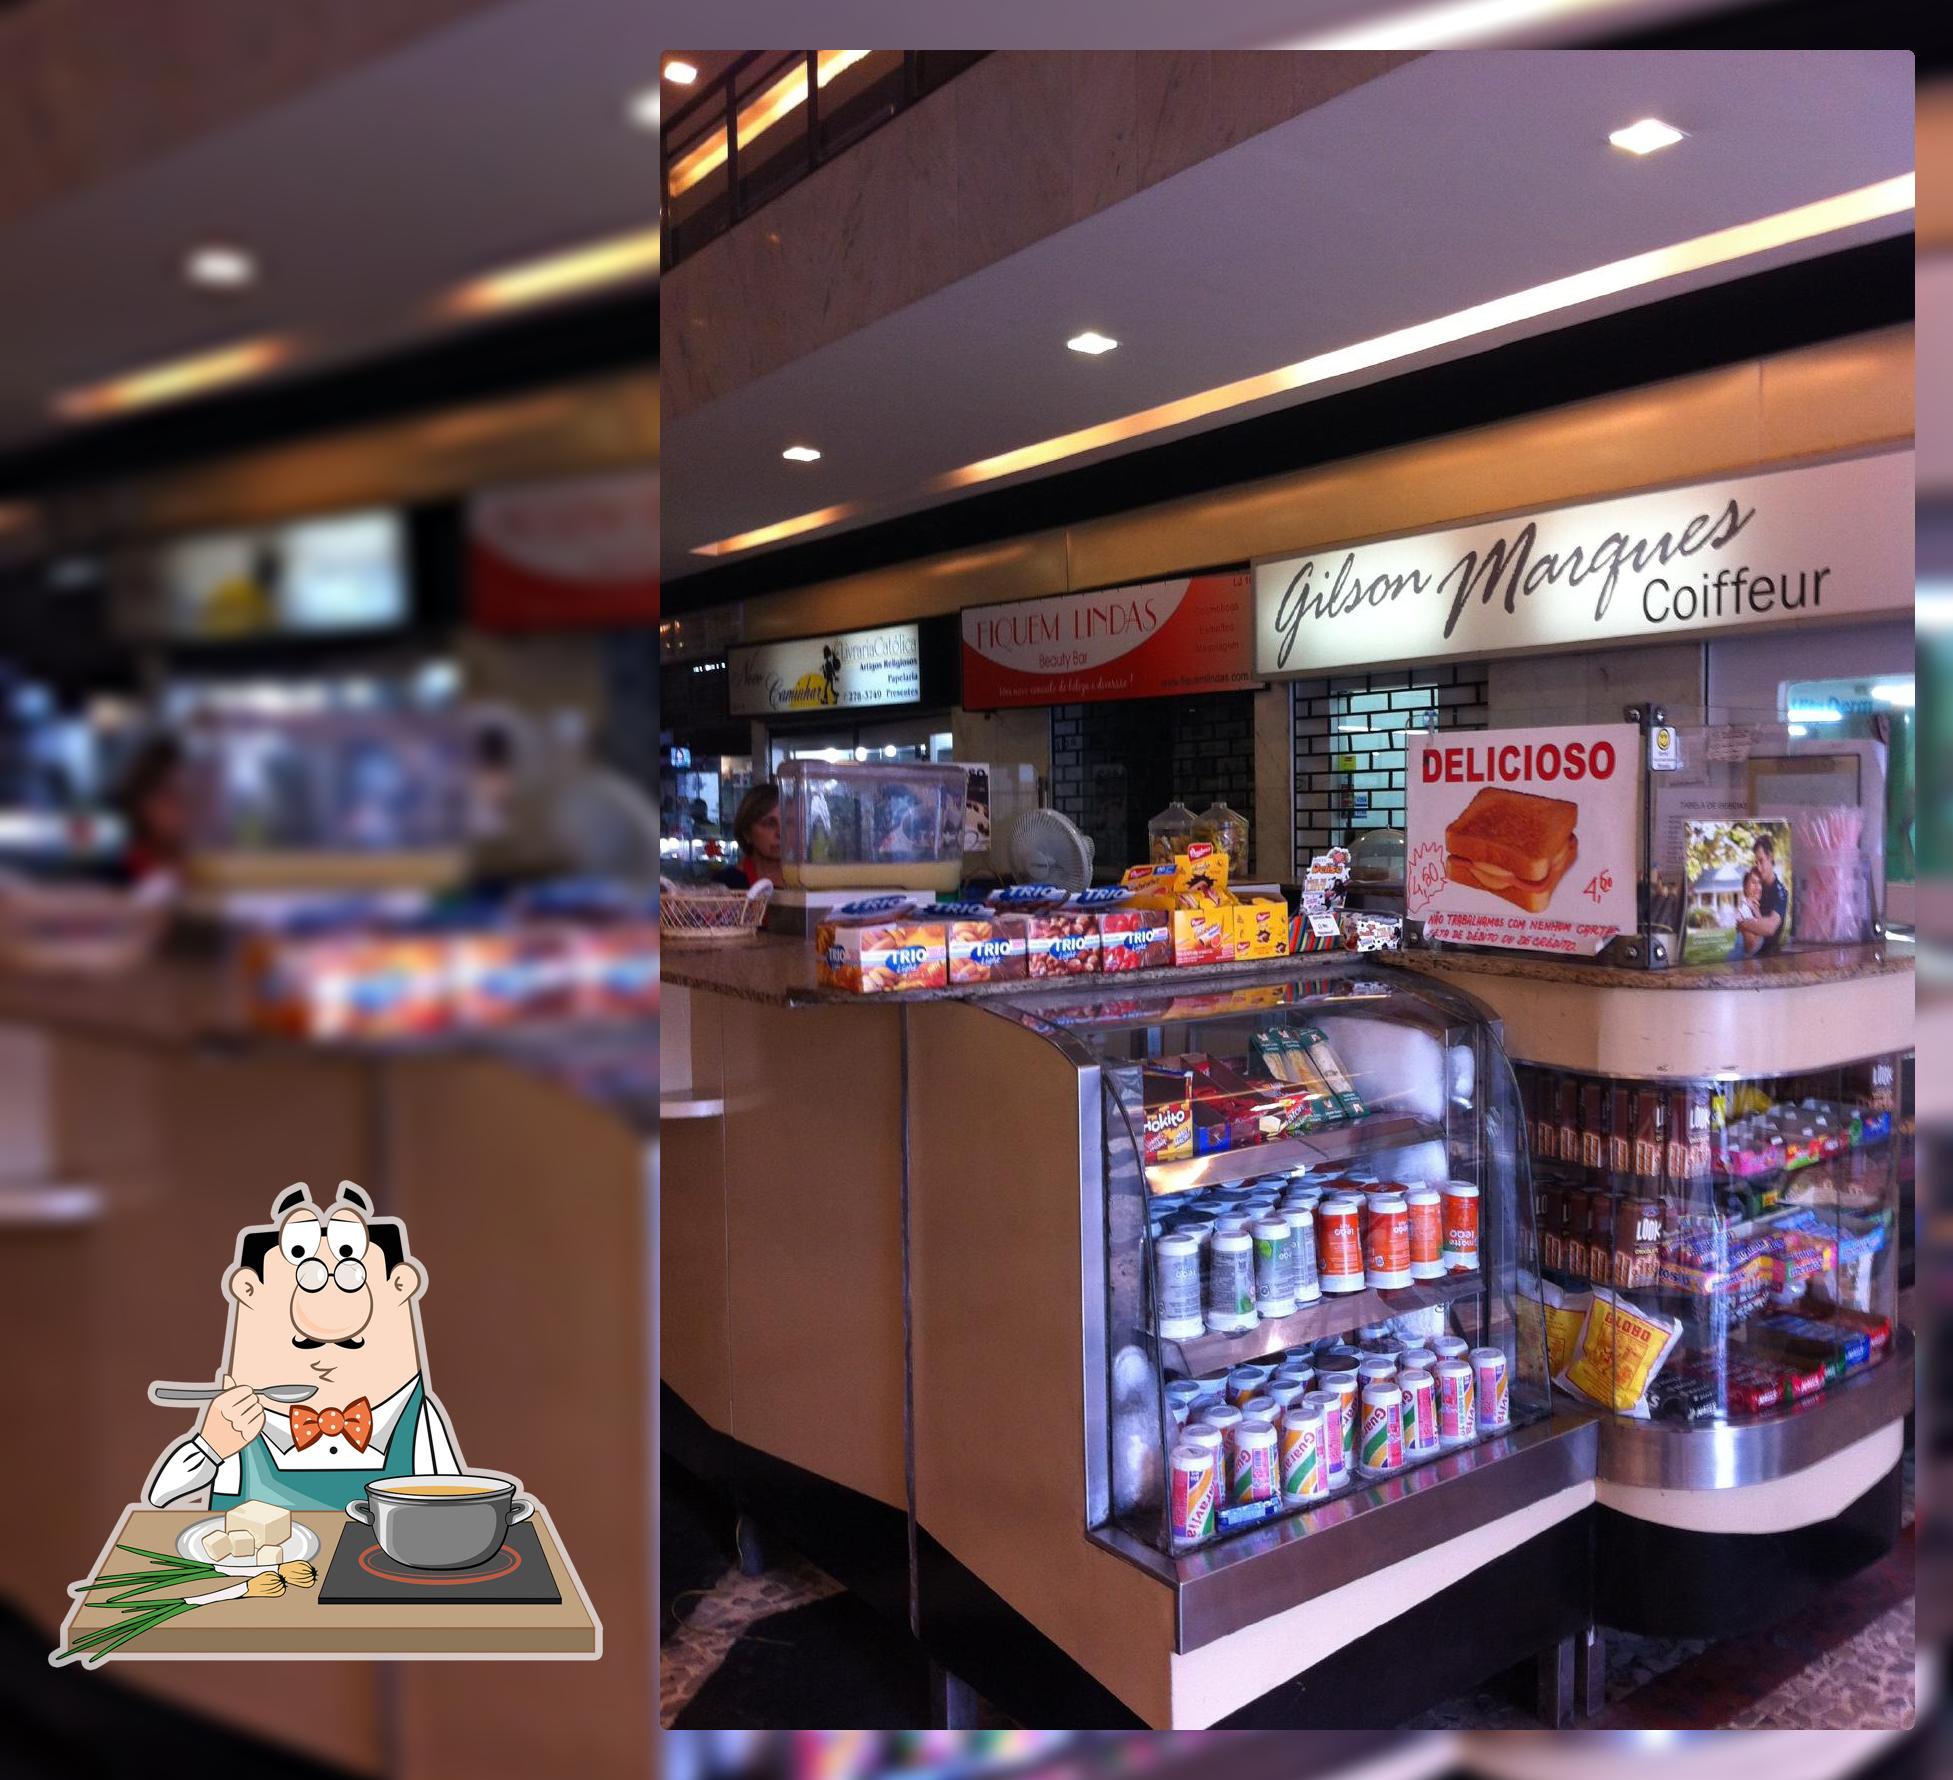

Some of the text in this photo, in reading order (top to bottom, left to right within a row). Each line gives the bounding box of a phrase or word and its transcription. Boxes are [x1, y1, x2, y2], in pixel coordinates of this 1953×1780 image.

[1275, 499, 1756, 669] Gilson Marques
[1642, 565, 1831, 625] Coiffeur
[976, 598, 1157, 652] FIQUEM LINDAS
[1039, 650, 1088, 670] Beauty Bar
[1422, 741, 1616, 783] DELICIOSO
[1009, 886, 1052, 898] TRIO
[1085, 888, 1124, 900] TRIO
[935, 903, 984, 914] TRIO
[1447, 914, 1504, 928] TRABALHAMOS
[1507, 916, 1525, 929] COM
[1530, 920, 1572, 933] NENHUM
[1055, 938, 1085, 953] TRIO
[1127, 930, 1154, 944] TRIO
[891, 948, 927, 966] TRIO
[976, 941, 1010, 957] TRIO
[1689, 1105, 1710, 1127] LOOK
[1635, 1217, 1661, 1241] LOOK
